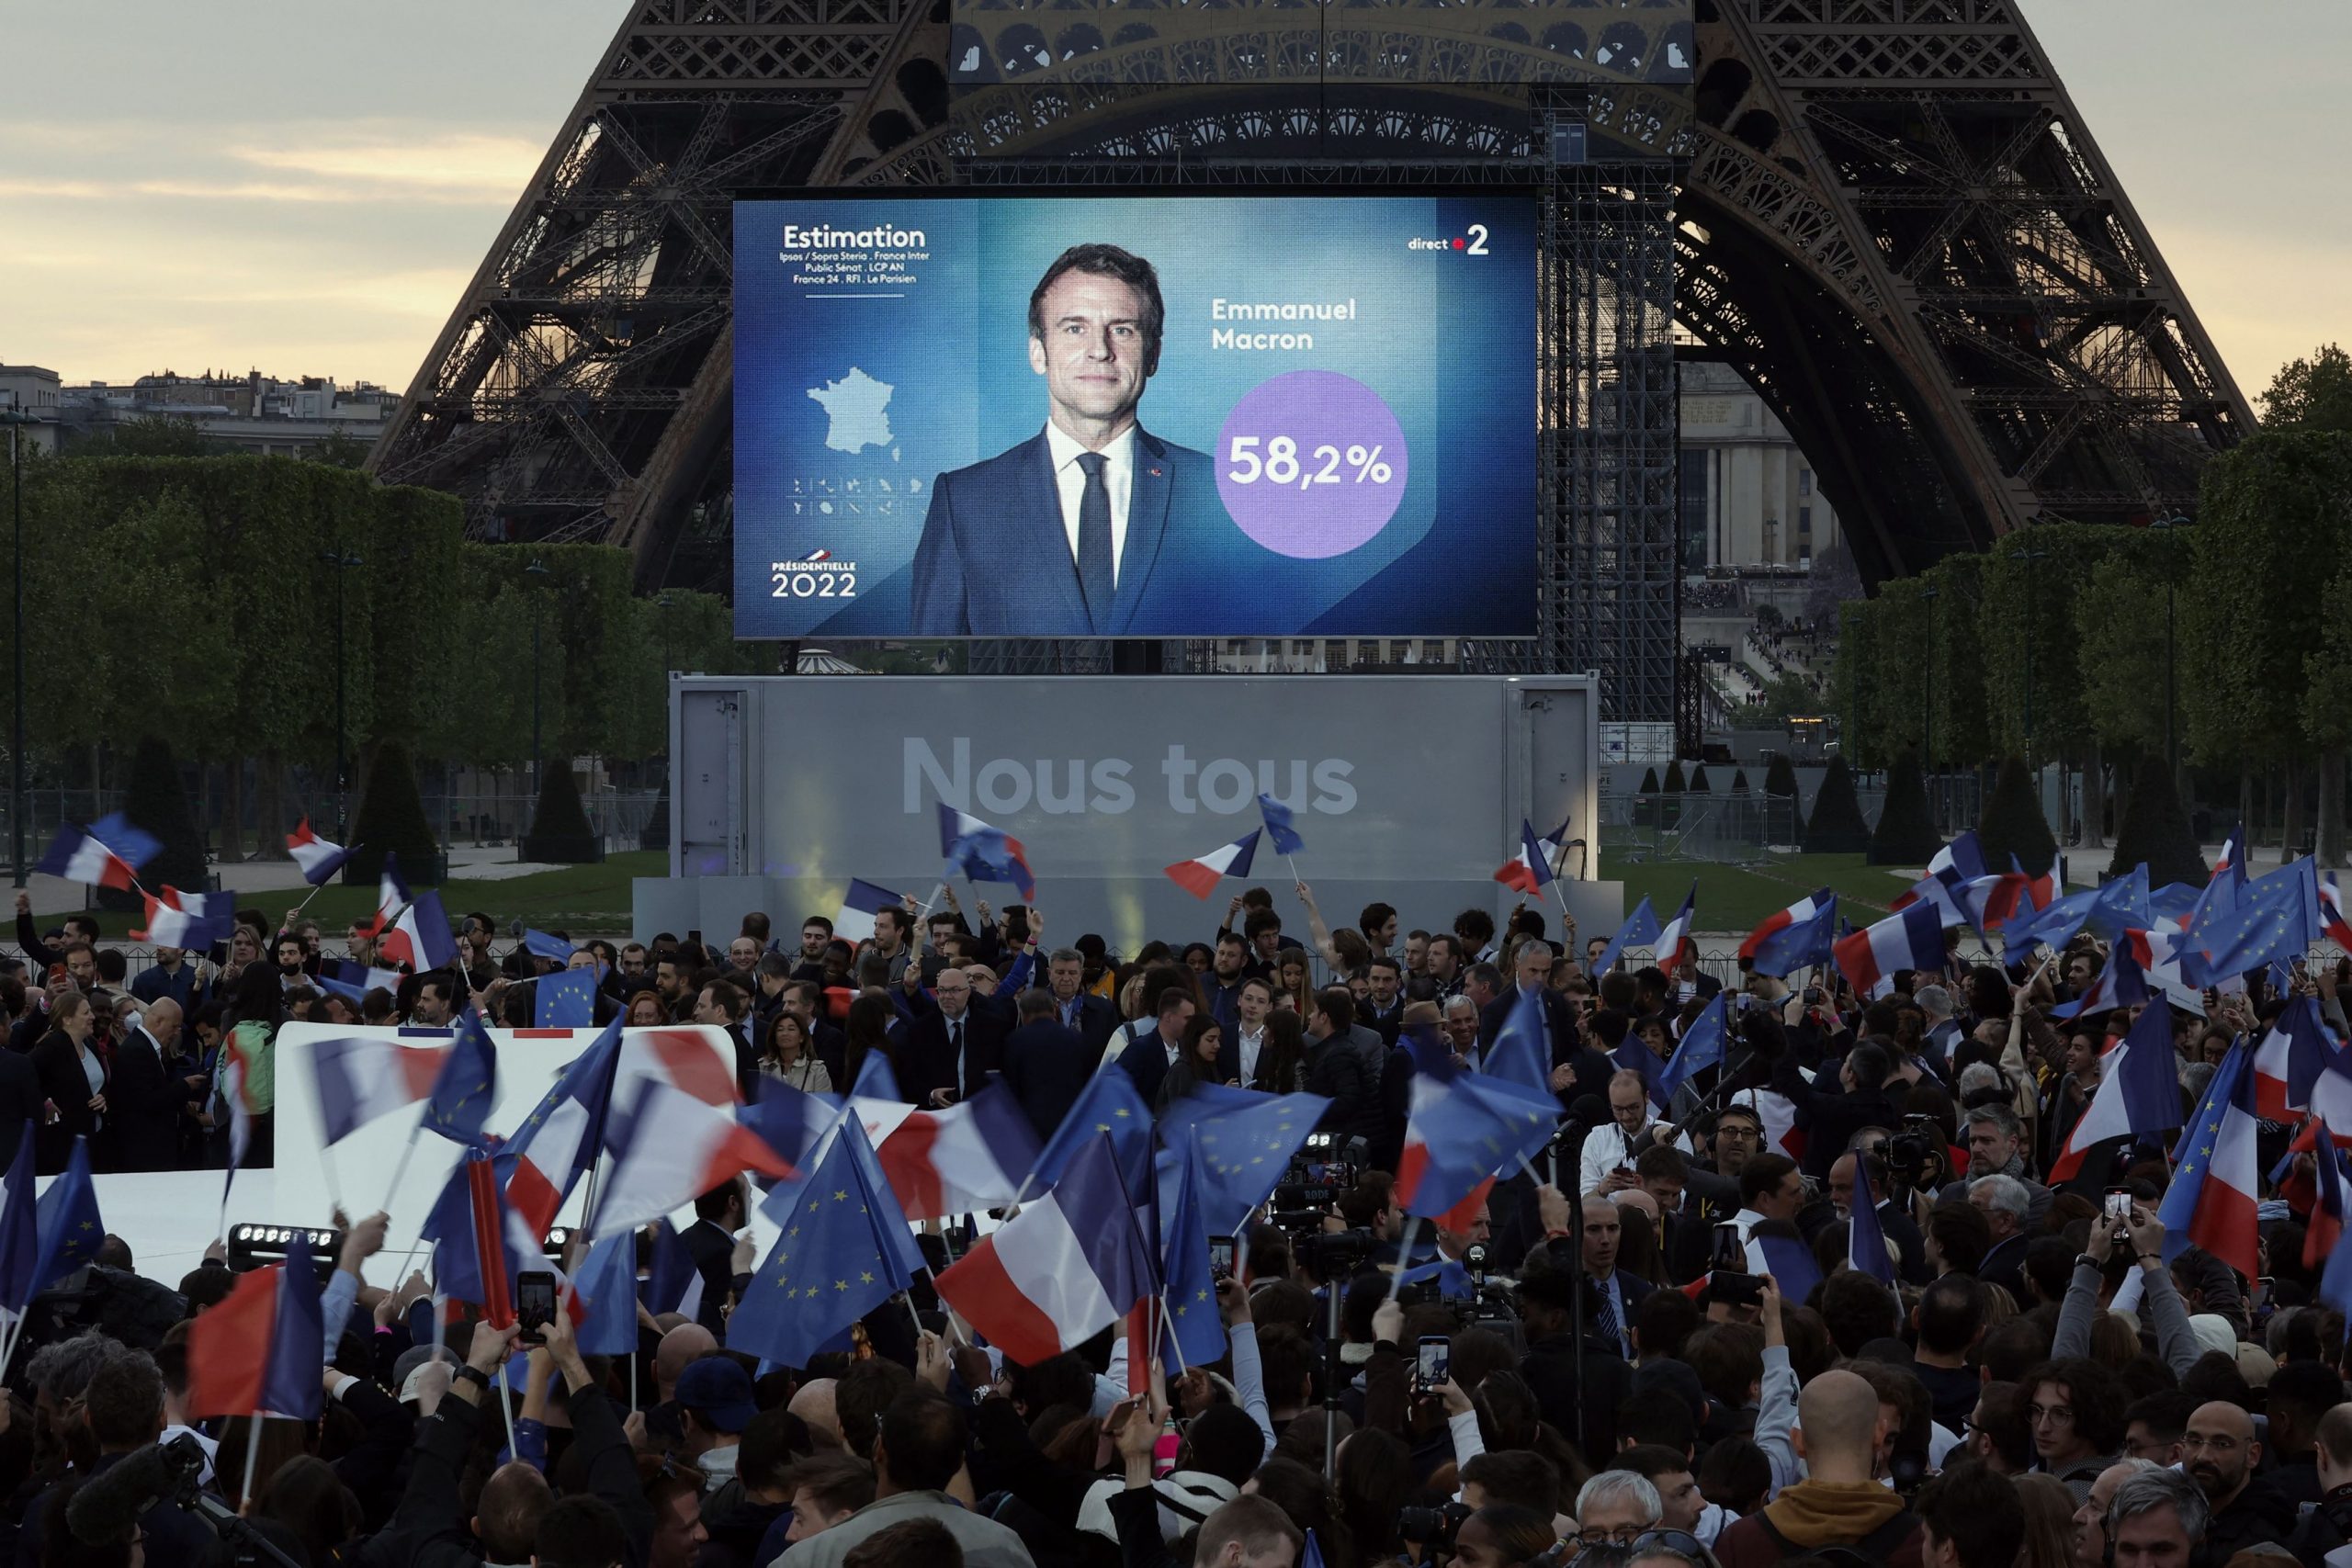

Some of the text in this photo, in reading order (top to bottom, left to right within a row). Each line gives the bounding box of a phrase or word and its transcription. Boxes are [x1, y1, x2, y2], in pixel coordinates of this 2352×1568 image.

[784, 223, 925, 248] Estimation
[1408, 224, 1489, 255] direct 2
[779, 252, 803, 263] Ipsos
[811, 251, 840, 263] Sopra
[840, 251, 867, 261] Steria
[874, 251, 906, 261] France
[907, 251, 930, 261] Inter
[805, 262, 905, 273] Public Sénat LCP AN
[793, 273, 917, 285] France 24 RFI Le Parisien
[1212, 298, 1356, 321] Emmanuel
[1212, 328, 1313, 350] Macron
[772, 559, 856, 571] PRÉSIDENTIELLE
[772, 572, 855, 598] 2022
[903, 737, 1358, 815] Nous tous
[1305, 1190, 1329, 1200] RØDE
